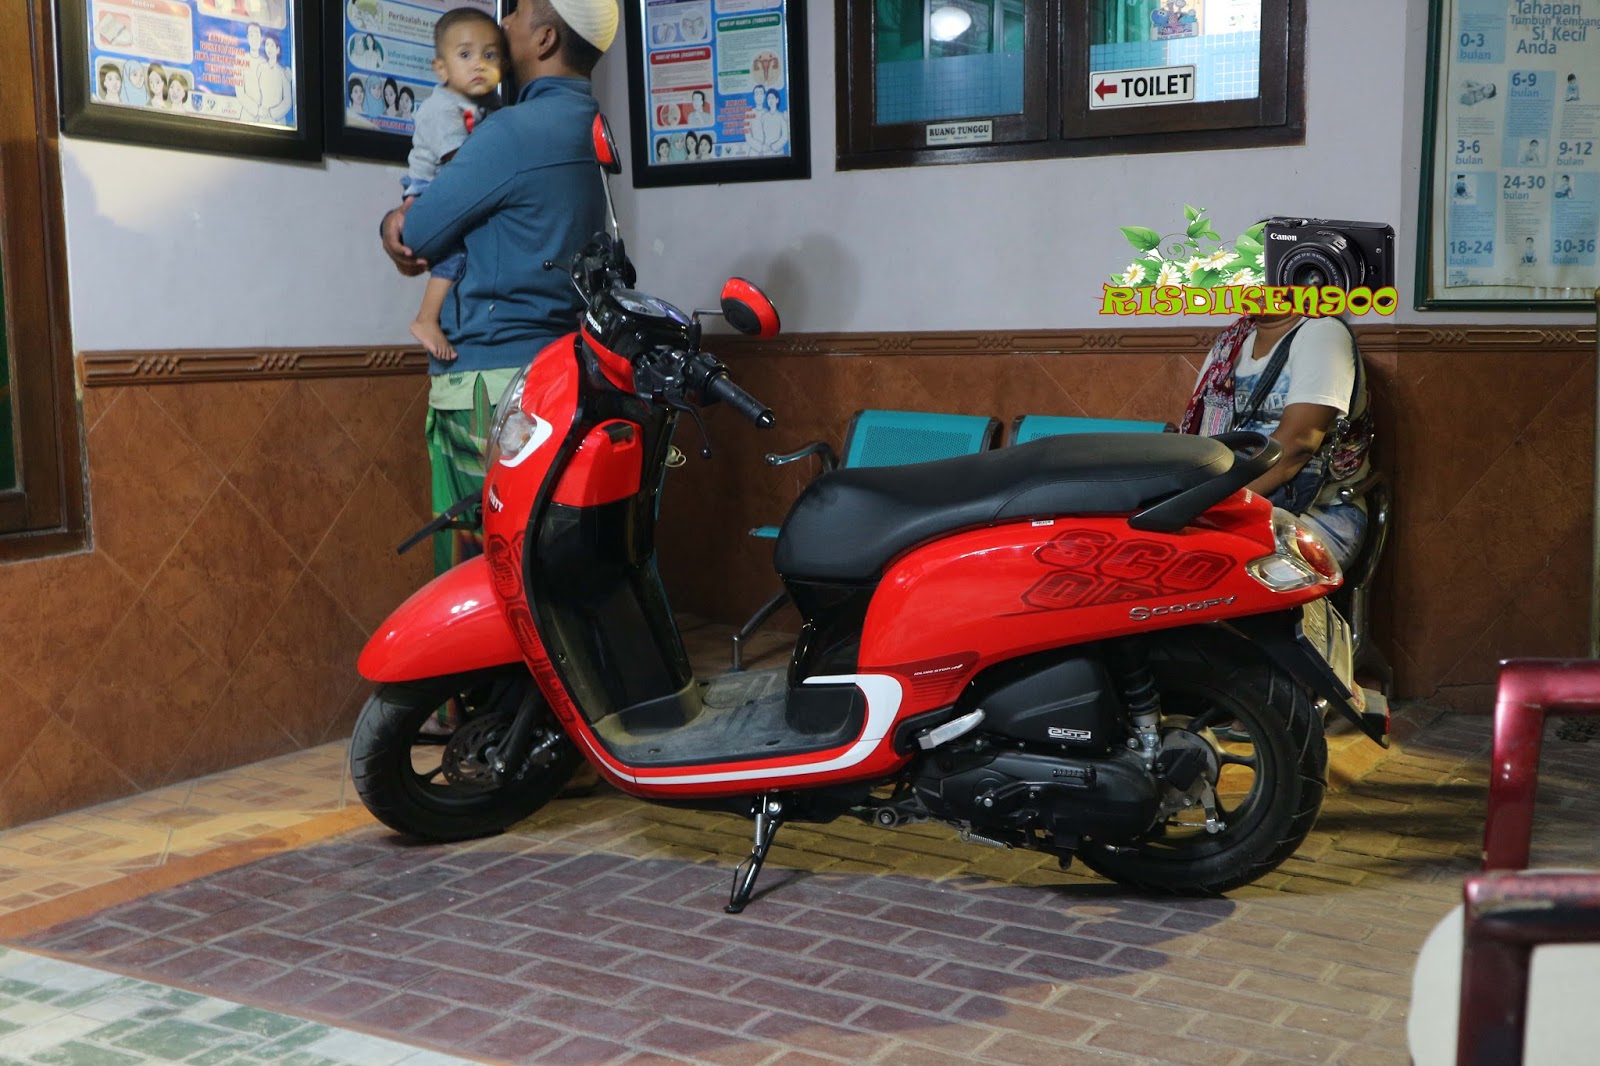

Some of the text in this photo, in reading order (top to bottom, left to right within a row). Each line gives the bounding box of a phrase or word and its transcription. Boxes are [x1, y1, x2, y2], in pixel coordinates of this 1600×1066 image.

[1515, 0, 1581, 18] Tahapan
[1510, 14, 1552, 25] Tumbuh
[1532, 25, 1587, 41] Si Kecil
[1460, 33, 1485, 47] 0-3
[1516, 39, 1557, 54] Anda
[1460, 50, 1491, 60] bulan
[1512, 72, 1537, 86] 6-9
[1121, 74, 1192, 98] TOILET
[1511, 88, 1539, 97] bulan
[929, 125, 990, 137] RUANG TUNGGU
[1457, 140, 1481, 153] 3-6
[1559, 142, 1592, 155] 9-12
[1456, 155, 1483, 165] bulan
[1556, 156, 1584, 166] bulan
[1503, 175, 1546, 189] 24-30
[1504, 191, 1529, 200] bulan
[1450, 240, 1493, 254] 18-24
[1554, 239, 1596, 253] 30-36
[1450, 256, 1477, 265] bulan
[1552, 255, 1579, 264] bulan
